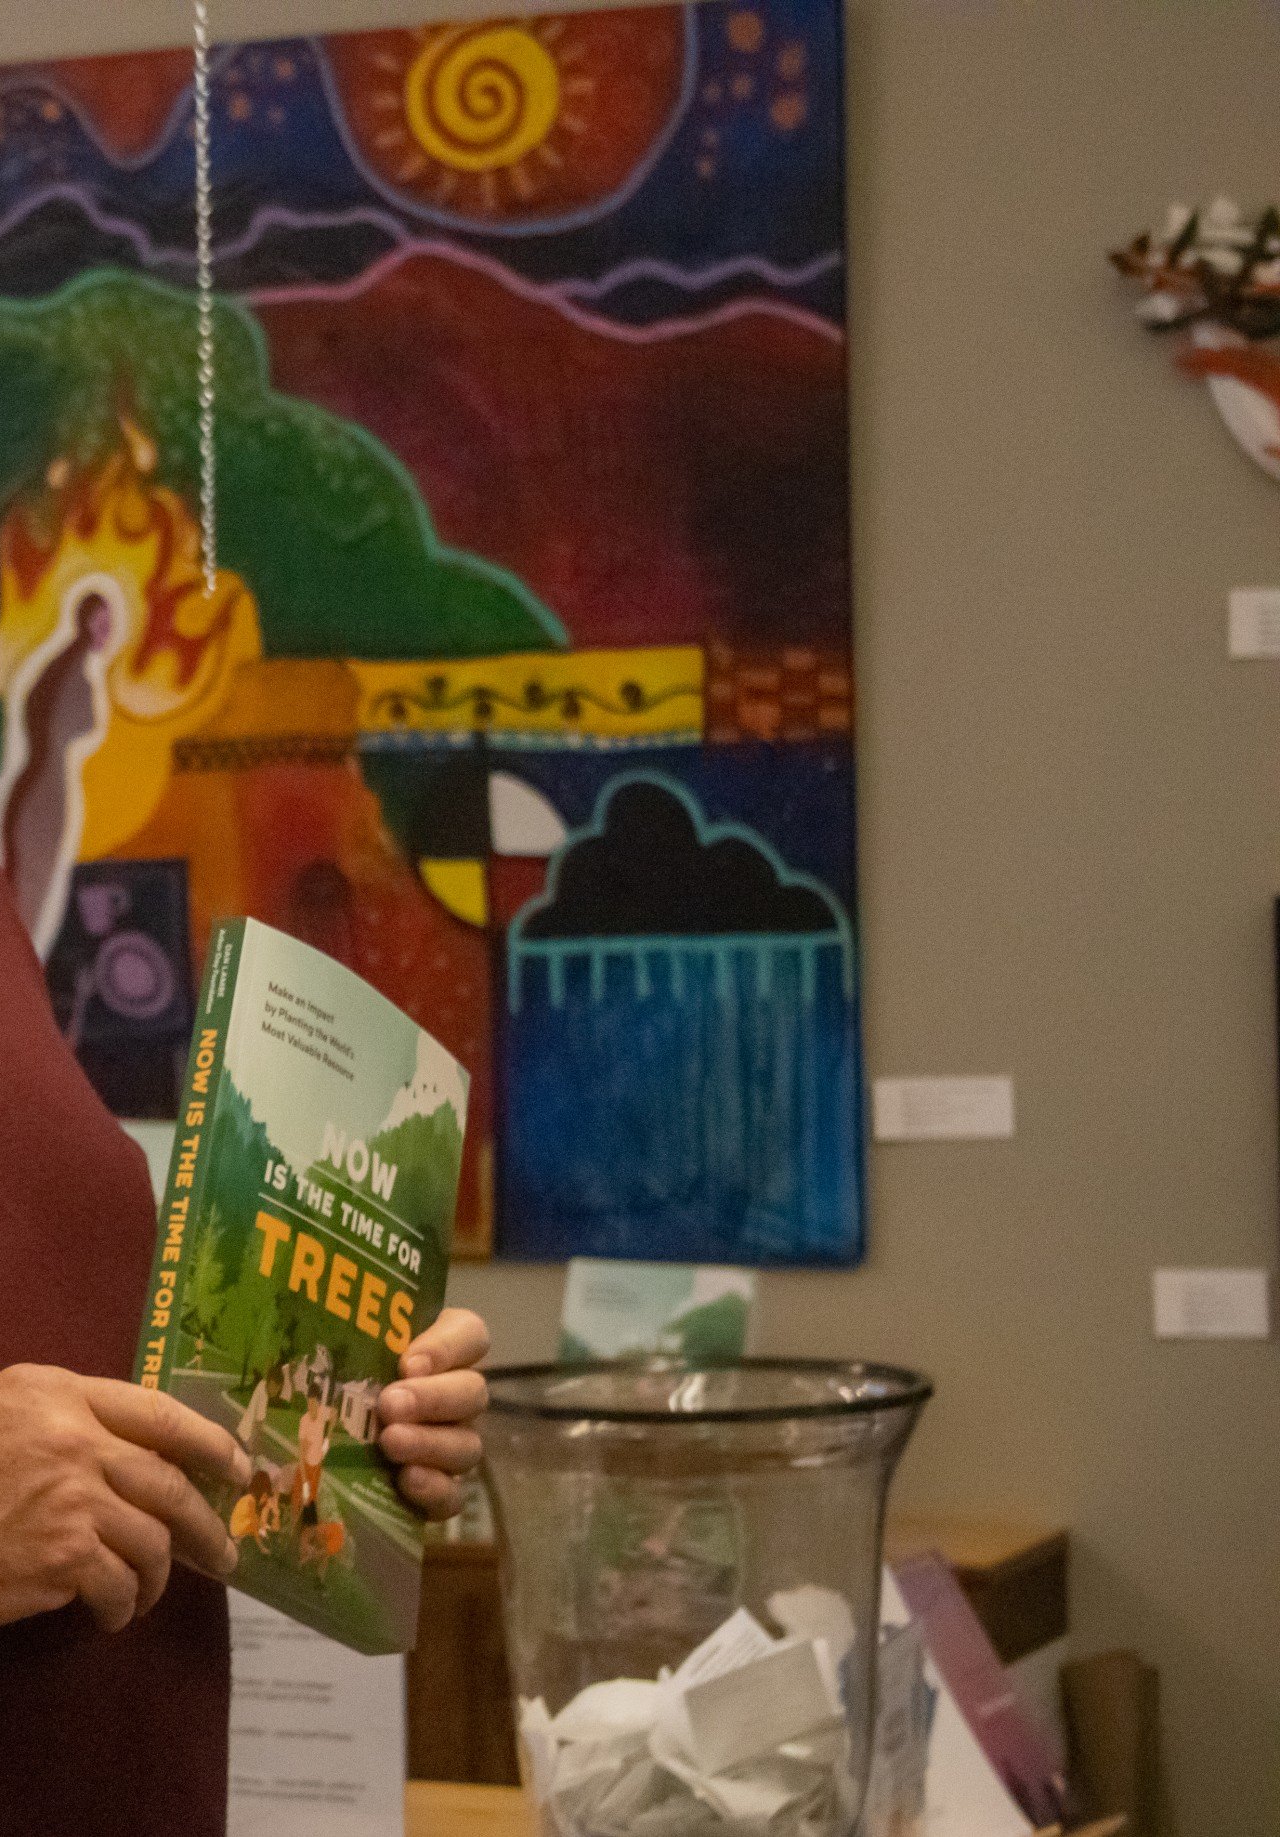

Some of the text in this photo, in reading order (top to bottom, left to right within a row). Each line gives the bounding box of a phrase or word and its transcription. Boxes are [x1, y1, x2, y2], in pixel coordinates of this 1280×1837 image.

[264, 1000, 355, 1061] by Planting the World's
[268, 981, 334, 1024] Make an Impact
[192, 1028, 218, 1094] NOW
[261, 1020, 355, 1082] Most Valuable Resource
[185, 1101, 206, 1127] IS
[175, 1134, 200, 1188] THE
[320, 1121, 398, 1201] NOW
[162, 1196, 190, 1264] TIME
[264, 1159, 422, 1275] IS THE TIME FOR
[150, 1271, 177, 1328] FOR
[255, 1210, 415, 1356] TREES
